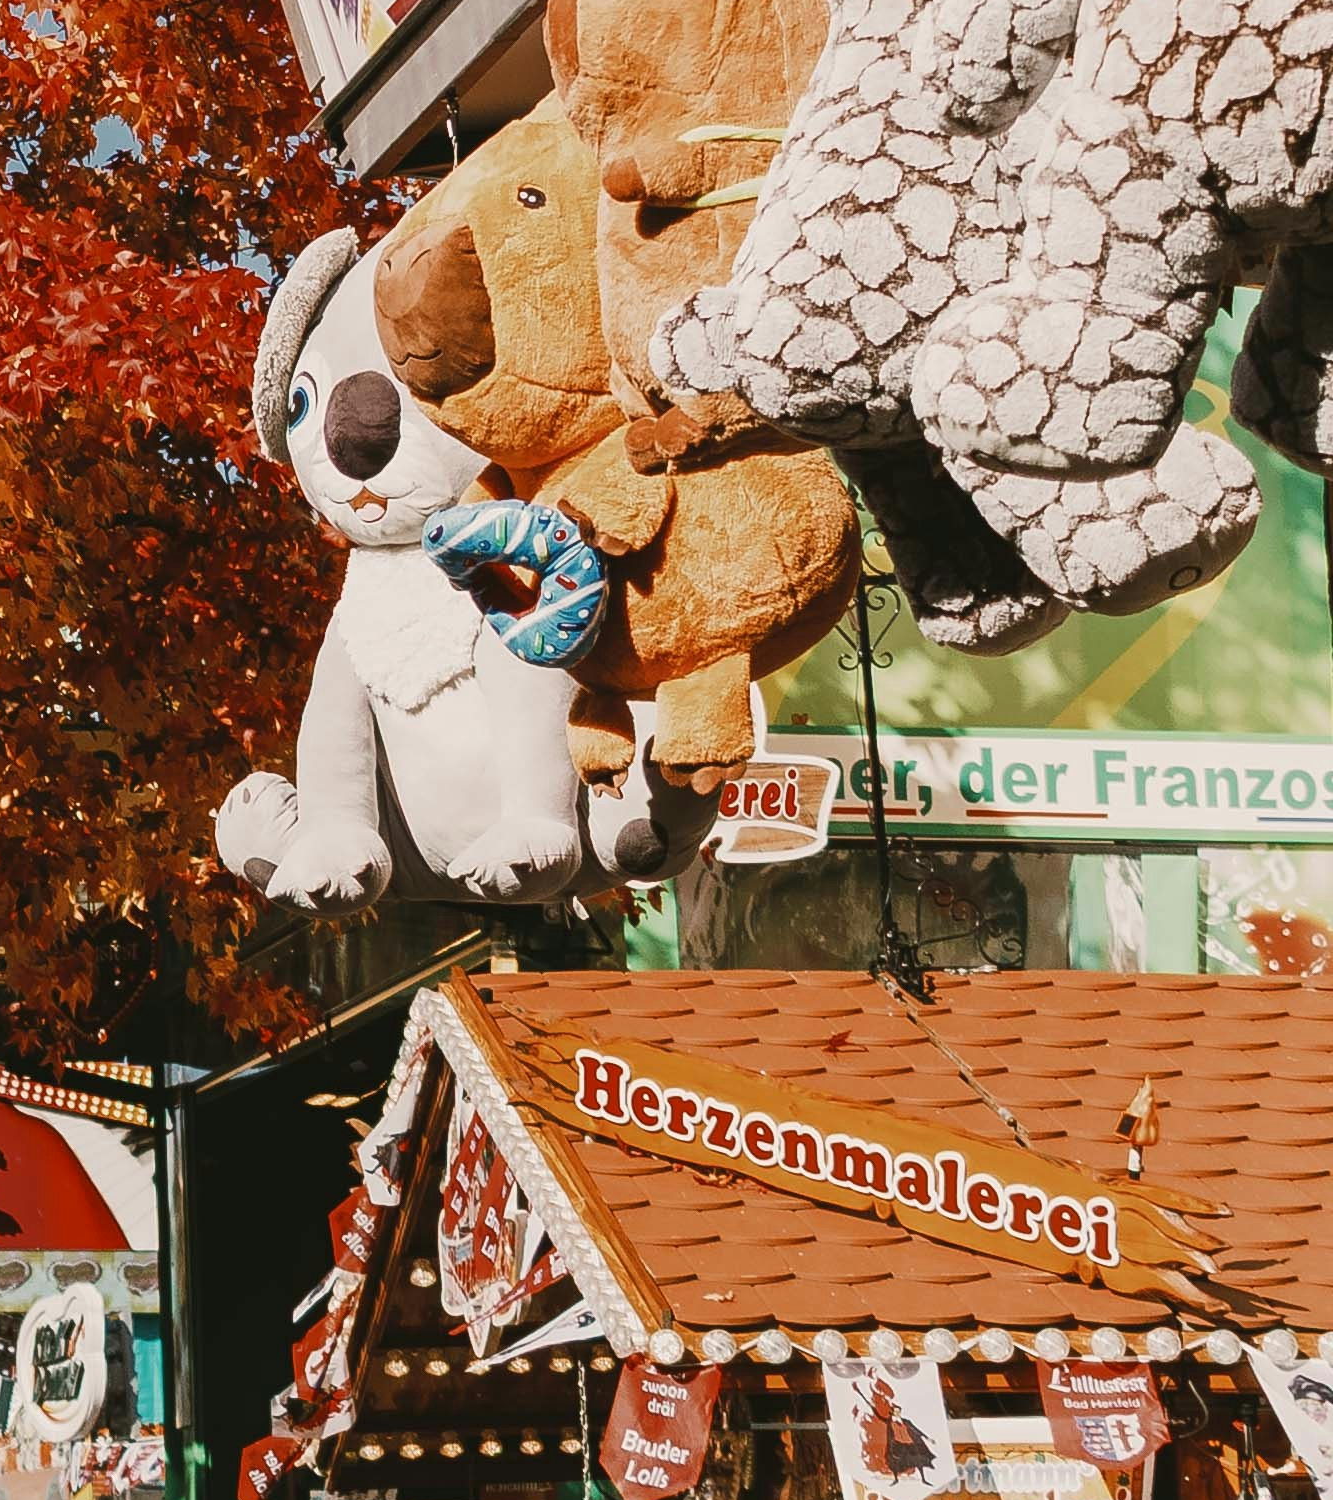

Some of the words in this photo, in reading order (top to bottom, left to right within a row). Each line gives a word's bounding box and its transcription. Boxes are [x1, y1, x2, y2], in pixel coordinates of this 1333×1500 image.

[959, 747, 1068, 805] der
[720, 768, 798, 818] erei
[576, 1050, 1120, 1266] Herzenmalerei
[641, 1379, 689, 1401] zwoon
[1045, 1364, 1150, 1395] Lullusfest
[647, 1397, 676, 1418] dräi
[1062, 1397, 1089, 1410] Bad
[620, 1428, 691, 1465] Bruder
[624, 1459, 670, 1489] Lolls
